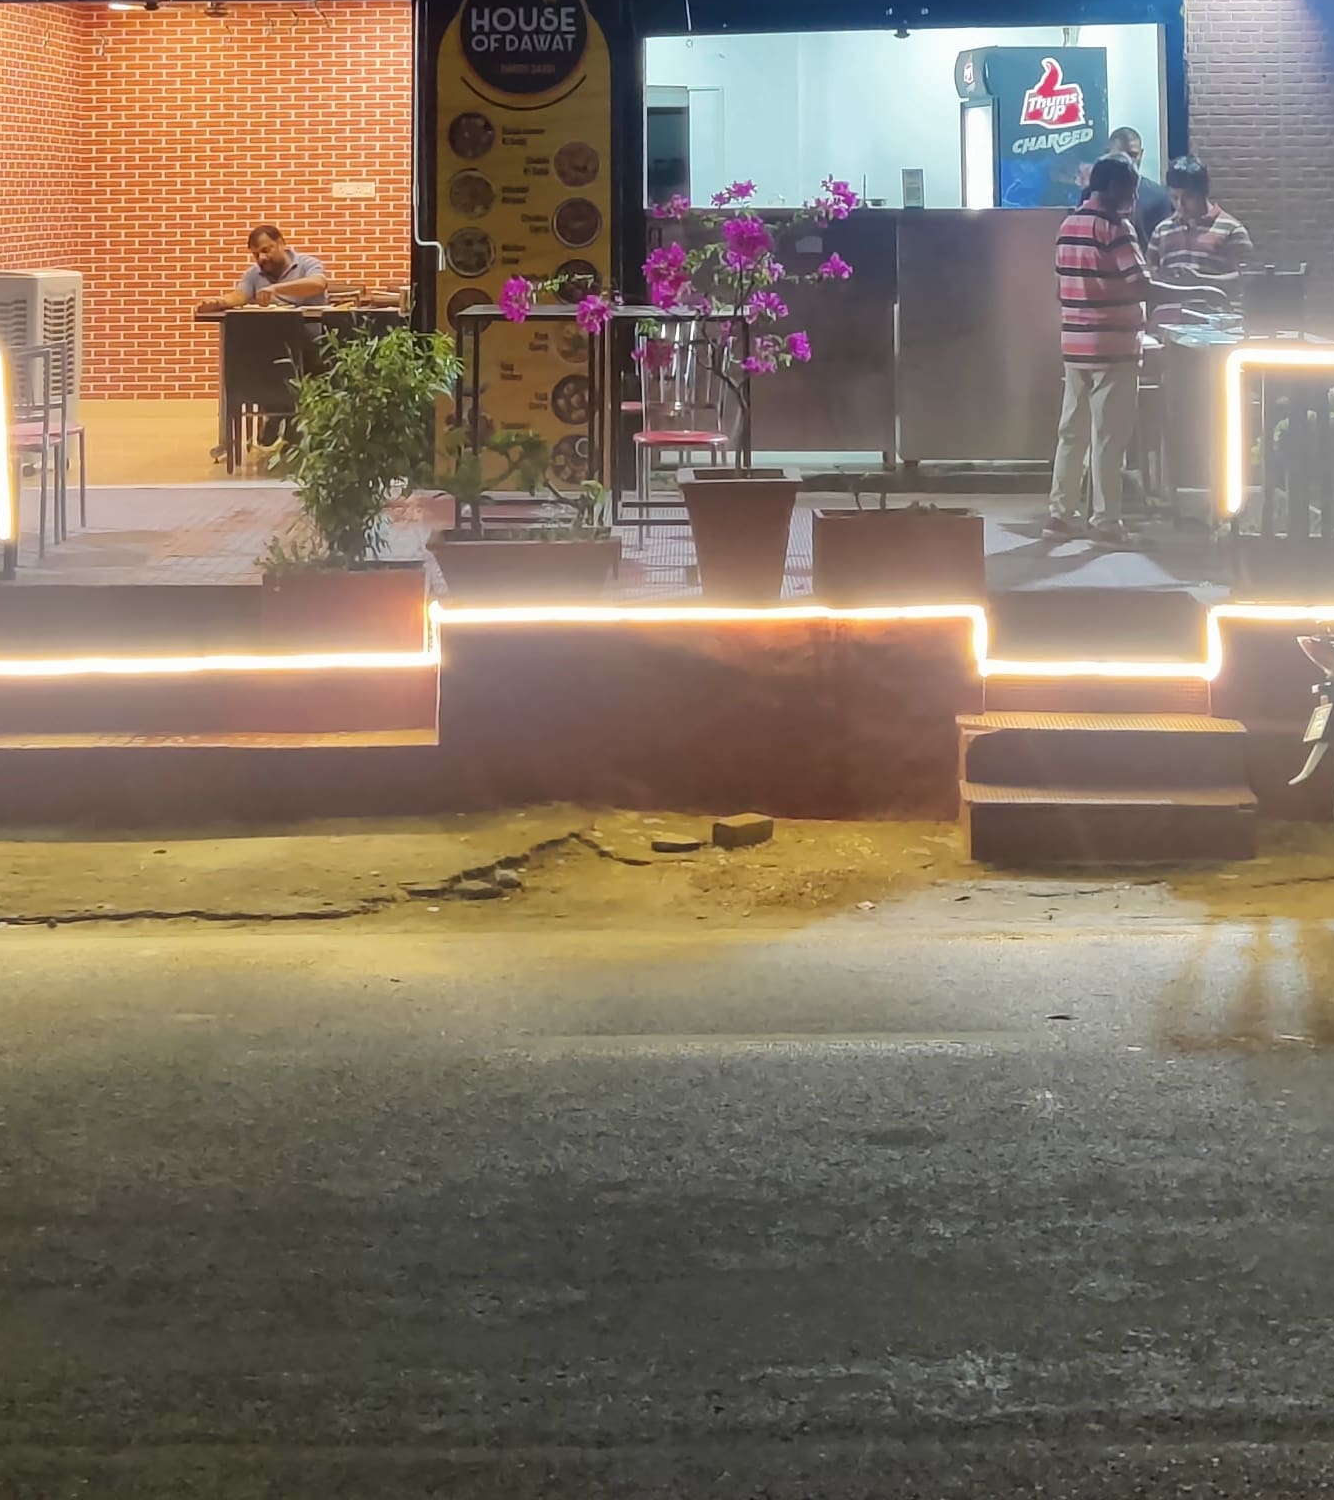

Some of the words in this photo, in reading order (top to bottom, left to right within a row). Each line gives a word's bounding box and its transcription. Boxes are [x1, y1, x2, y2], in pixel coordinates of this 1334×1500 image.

[471, 6, 576, 33] HOUSE
[471, 34, 503, 52] OF
[505, 33, 576, 52] DAWAT
[1028, 92, 1078, 113] Thums
[1011, 127, 1094, 155] CHARGED
